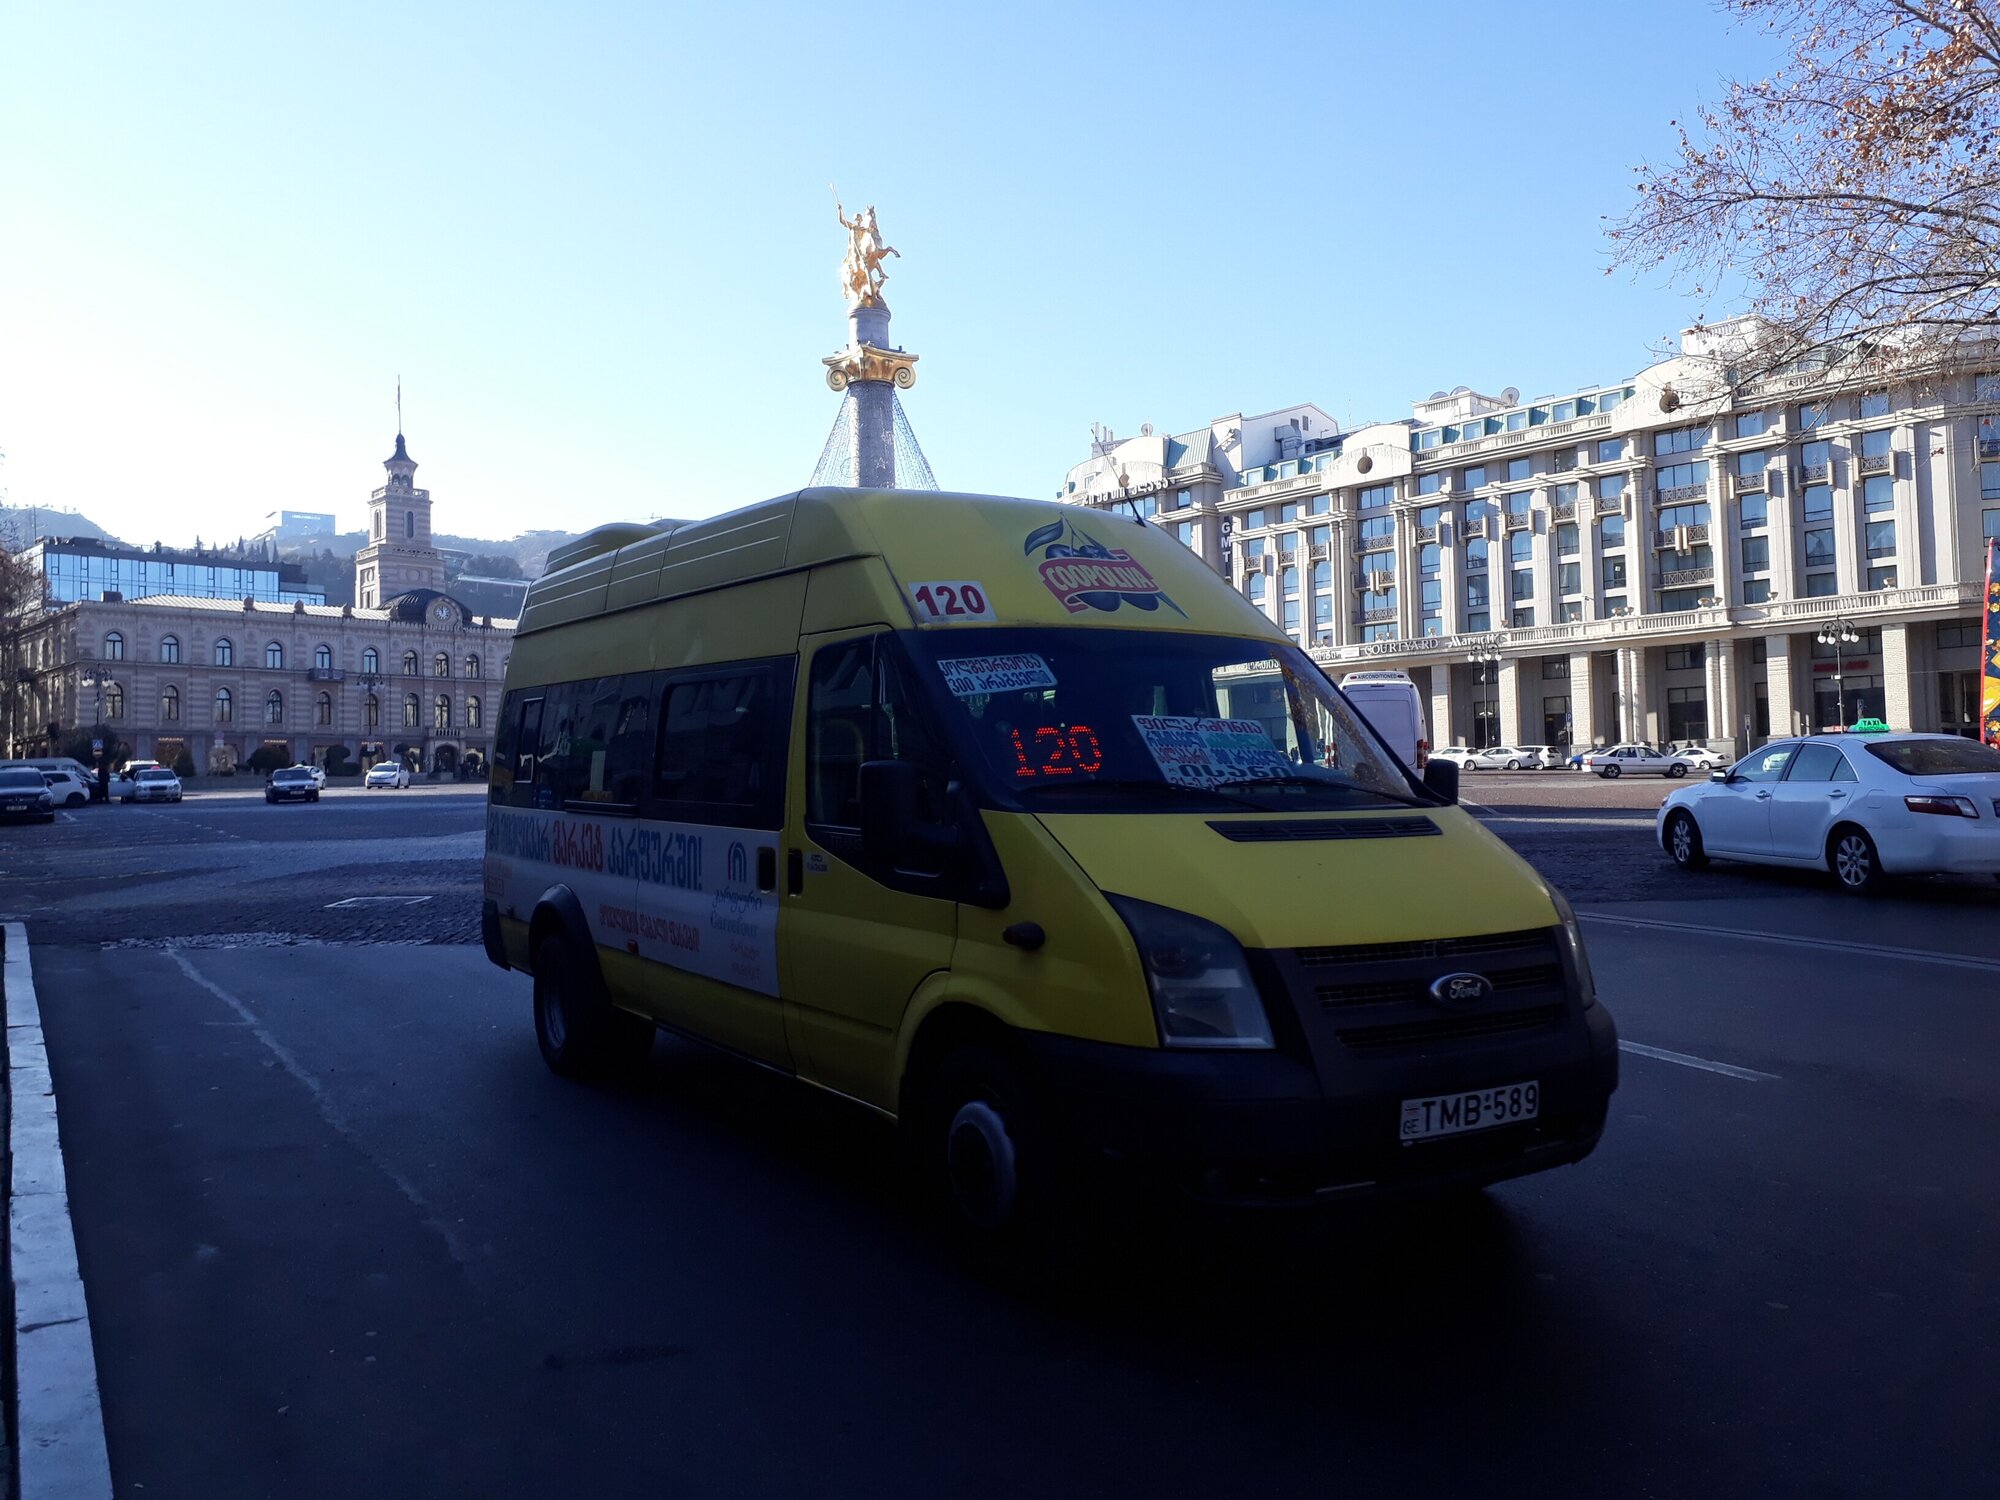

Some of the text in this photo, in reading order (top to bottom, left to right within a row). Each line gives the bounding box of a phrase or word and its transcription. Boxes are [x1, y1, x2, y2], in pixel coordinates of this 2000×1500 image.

[1046, 564, 1154, 592] COOPOLIVA
[915, 584, 986, 616] 120
[1364, 633, 1495, 656] COURTYARD Marriott
[1137, 717, 1262, 734] ფილარმონია
[1011, 726, 1102, 776] 120
[1178, 764, 1290, 777] ისანი
[553, 820, 604, 872] მარკეტ
[608, 827, 702, 891] კარფურში!
[710, 910, 759, 938] Carrefour
[1449, 979, 1482, 999] Ford
[1421, 1084, 1538, 1132] TMB-589
